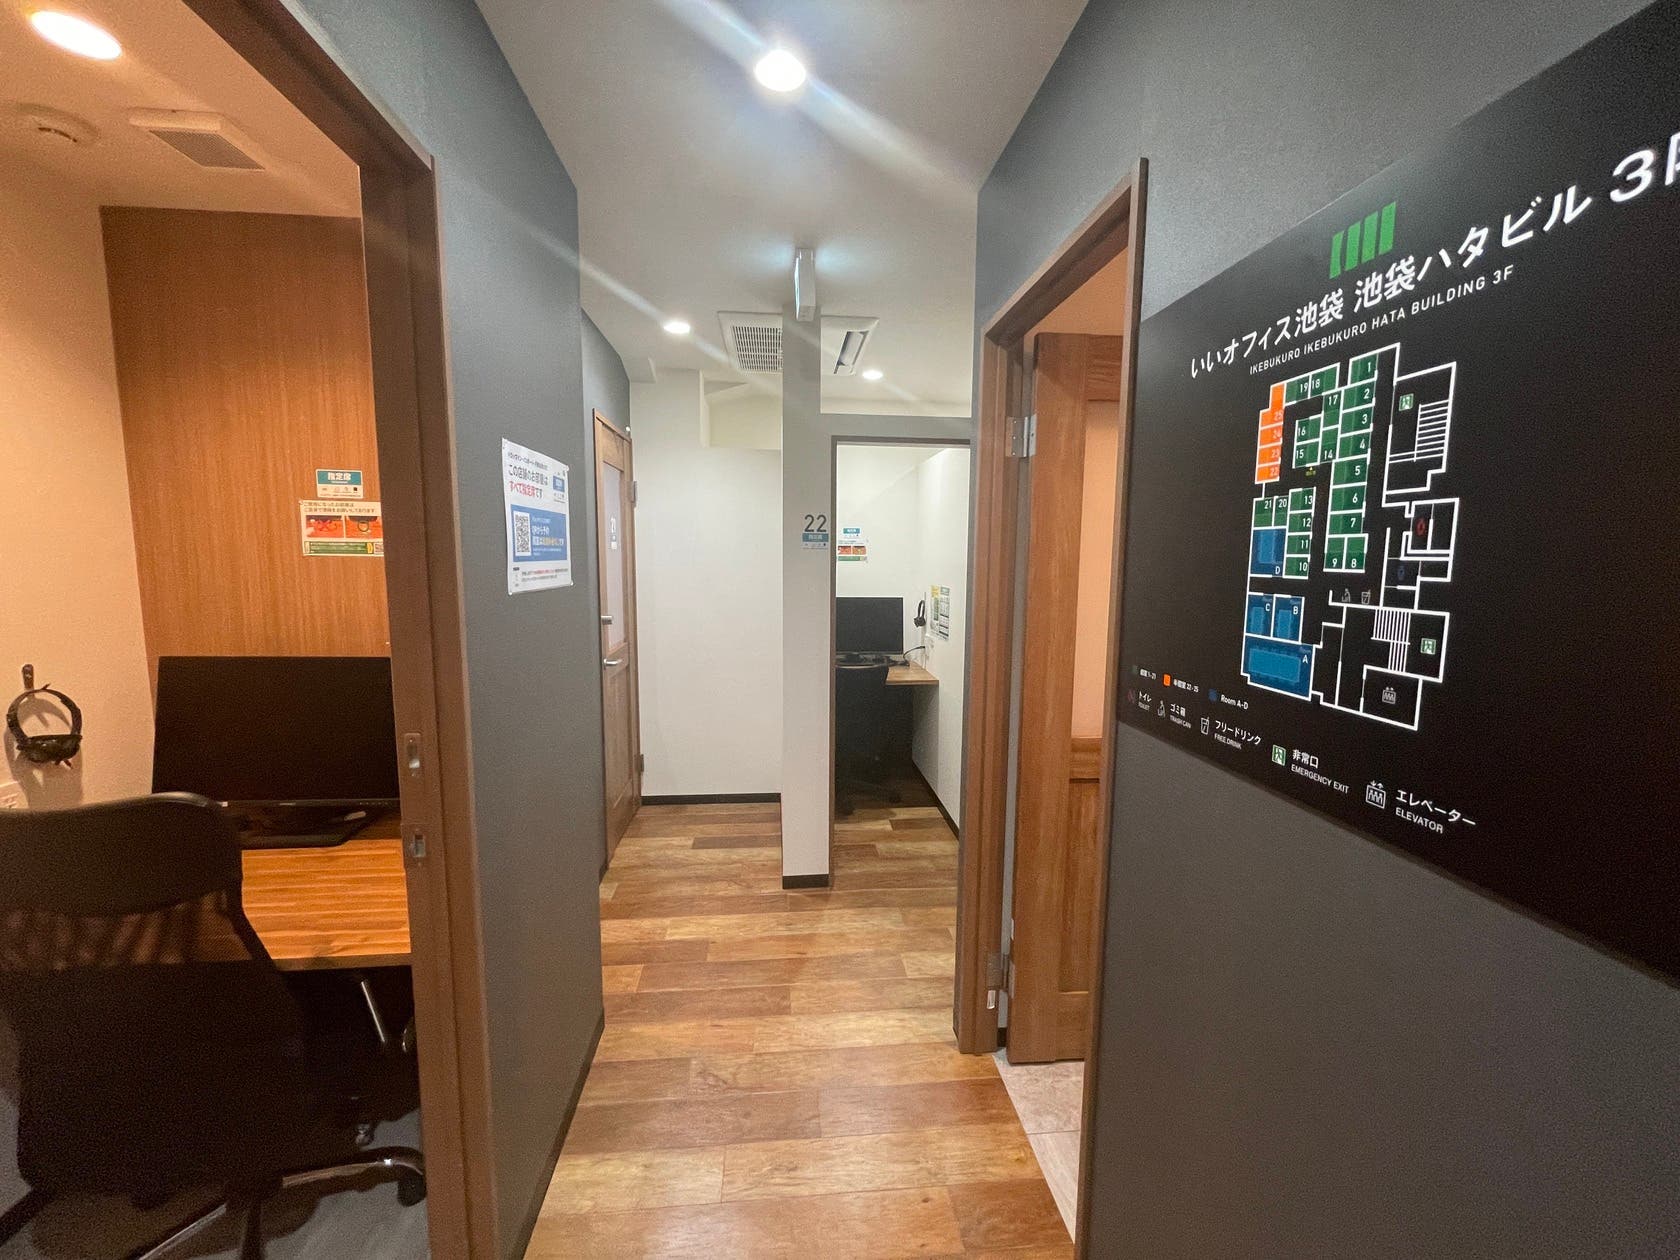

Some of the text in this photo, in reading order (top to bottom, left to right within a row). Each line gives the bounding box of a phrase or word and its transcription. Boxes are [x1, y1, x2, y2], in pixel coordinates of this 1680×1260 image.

[1191, 288, 1343, 378] いいオフィス池袋
[1354, 185, 1592, 314] 池袋ハタビル
[1250, 264, 1513, 375] IKEBUKURO IKEBUKURO HATA BUILDING 3F
[1367, 361, 1372, 372] 1
[1300, 382, 1308, 393] 19
[1311, 377, 1320, 390] 18
[1363, 388, 1370, 400] 2
[1328, 394, 1338, 406] 17
[1362, 414, 1368, 424] 3
[1297, 426, 1306, 437] 16
[1359, 437, 1366, 449] 4
[1296, 449, 1304, 460] 15
[1324, 449, 1333, 460] 14
[1355, 465, 1361, 476] 5
[1304, 495, 1313, 505] 13
[1352, 492, 1358, 503] 6
[1264, 498, 1272, 509] 21
[1279, 498, 1287, 509] 20
[804, 514, 827, 532] 22
[1302, 517, 1311, 527] 12
[1350, 517, 1356, 528] 7
[1300, 539, 1309, 549] 11
[1299, 561, 1308, 572] 10
[1332, 556, 1338, 568] 9
[1351, 557, 1357, 568] 8
[1275, 565, 1281, 575] D
[1265, 602, 1271, 613] C
[1293, 605, 1299, 615] B
[1302, 654, 1308, 664] A
[1139, 691, 1152, 702] トイレ
[1221, 695, 1249, 710] Room A-D
[1214, 733, 1227, 743] FREE
[1215, 720, 1261, 745] フリードリンク
[1292, 749, 1319, 769] 非常口
[1291, 764, 1349, 794] EMERGENCY EXIT
[1396, 790, 1476, 826] エレベーター
[1396, 807, 1444, 833] ELEVATOR
